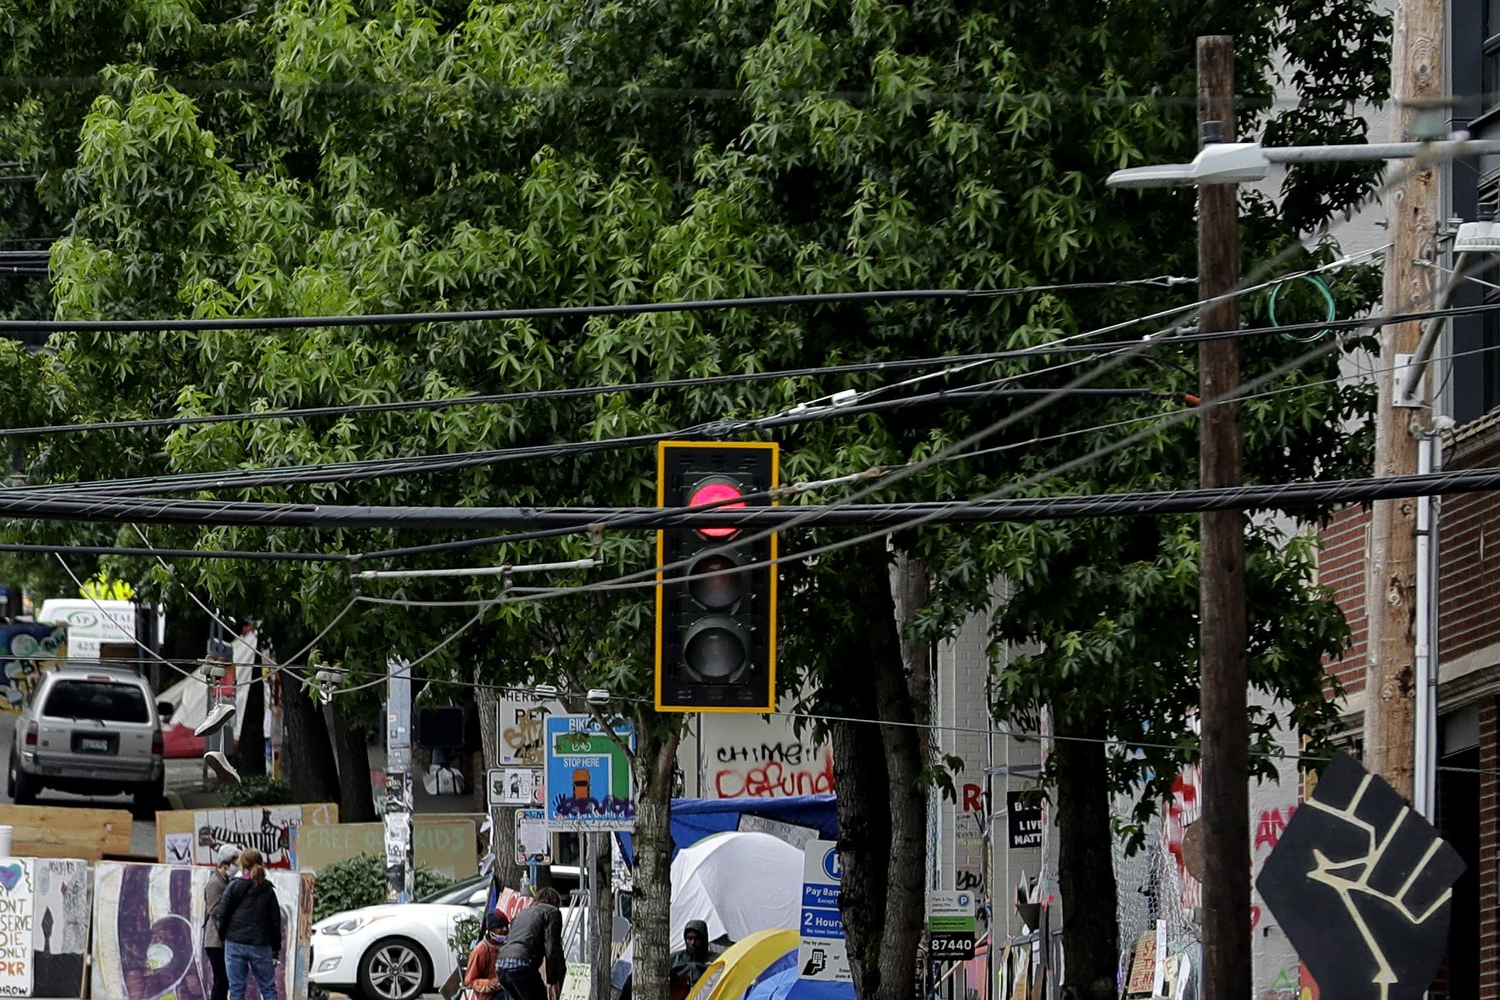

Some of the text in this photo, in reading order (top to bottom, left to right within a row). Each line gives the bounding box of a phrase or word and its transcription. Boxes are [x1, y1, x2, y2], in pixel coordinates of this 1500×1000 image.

[564, 758, 600, 768] STOP HERE
[1019, 820, 1042, 831] LIVE
[1014, 835, 1041, 845] MATT
[806, 886, 821, 897] Pay
[804, 912, 843, 927] 2 Hours
[932, 939, 972, 950] 87440
